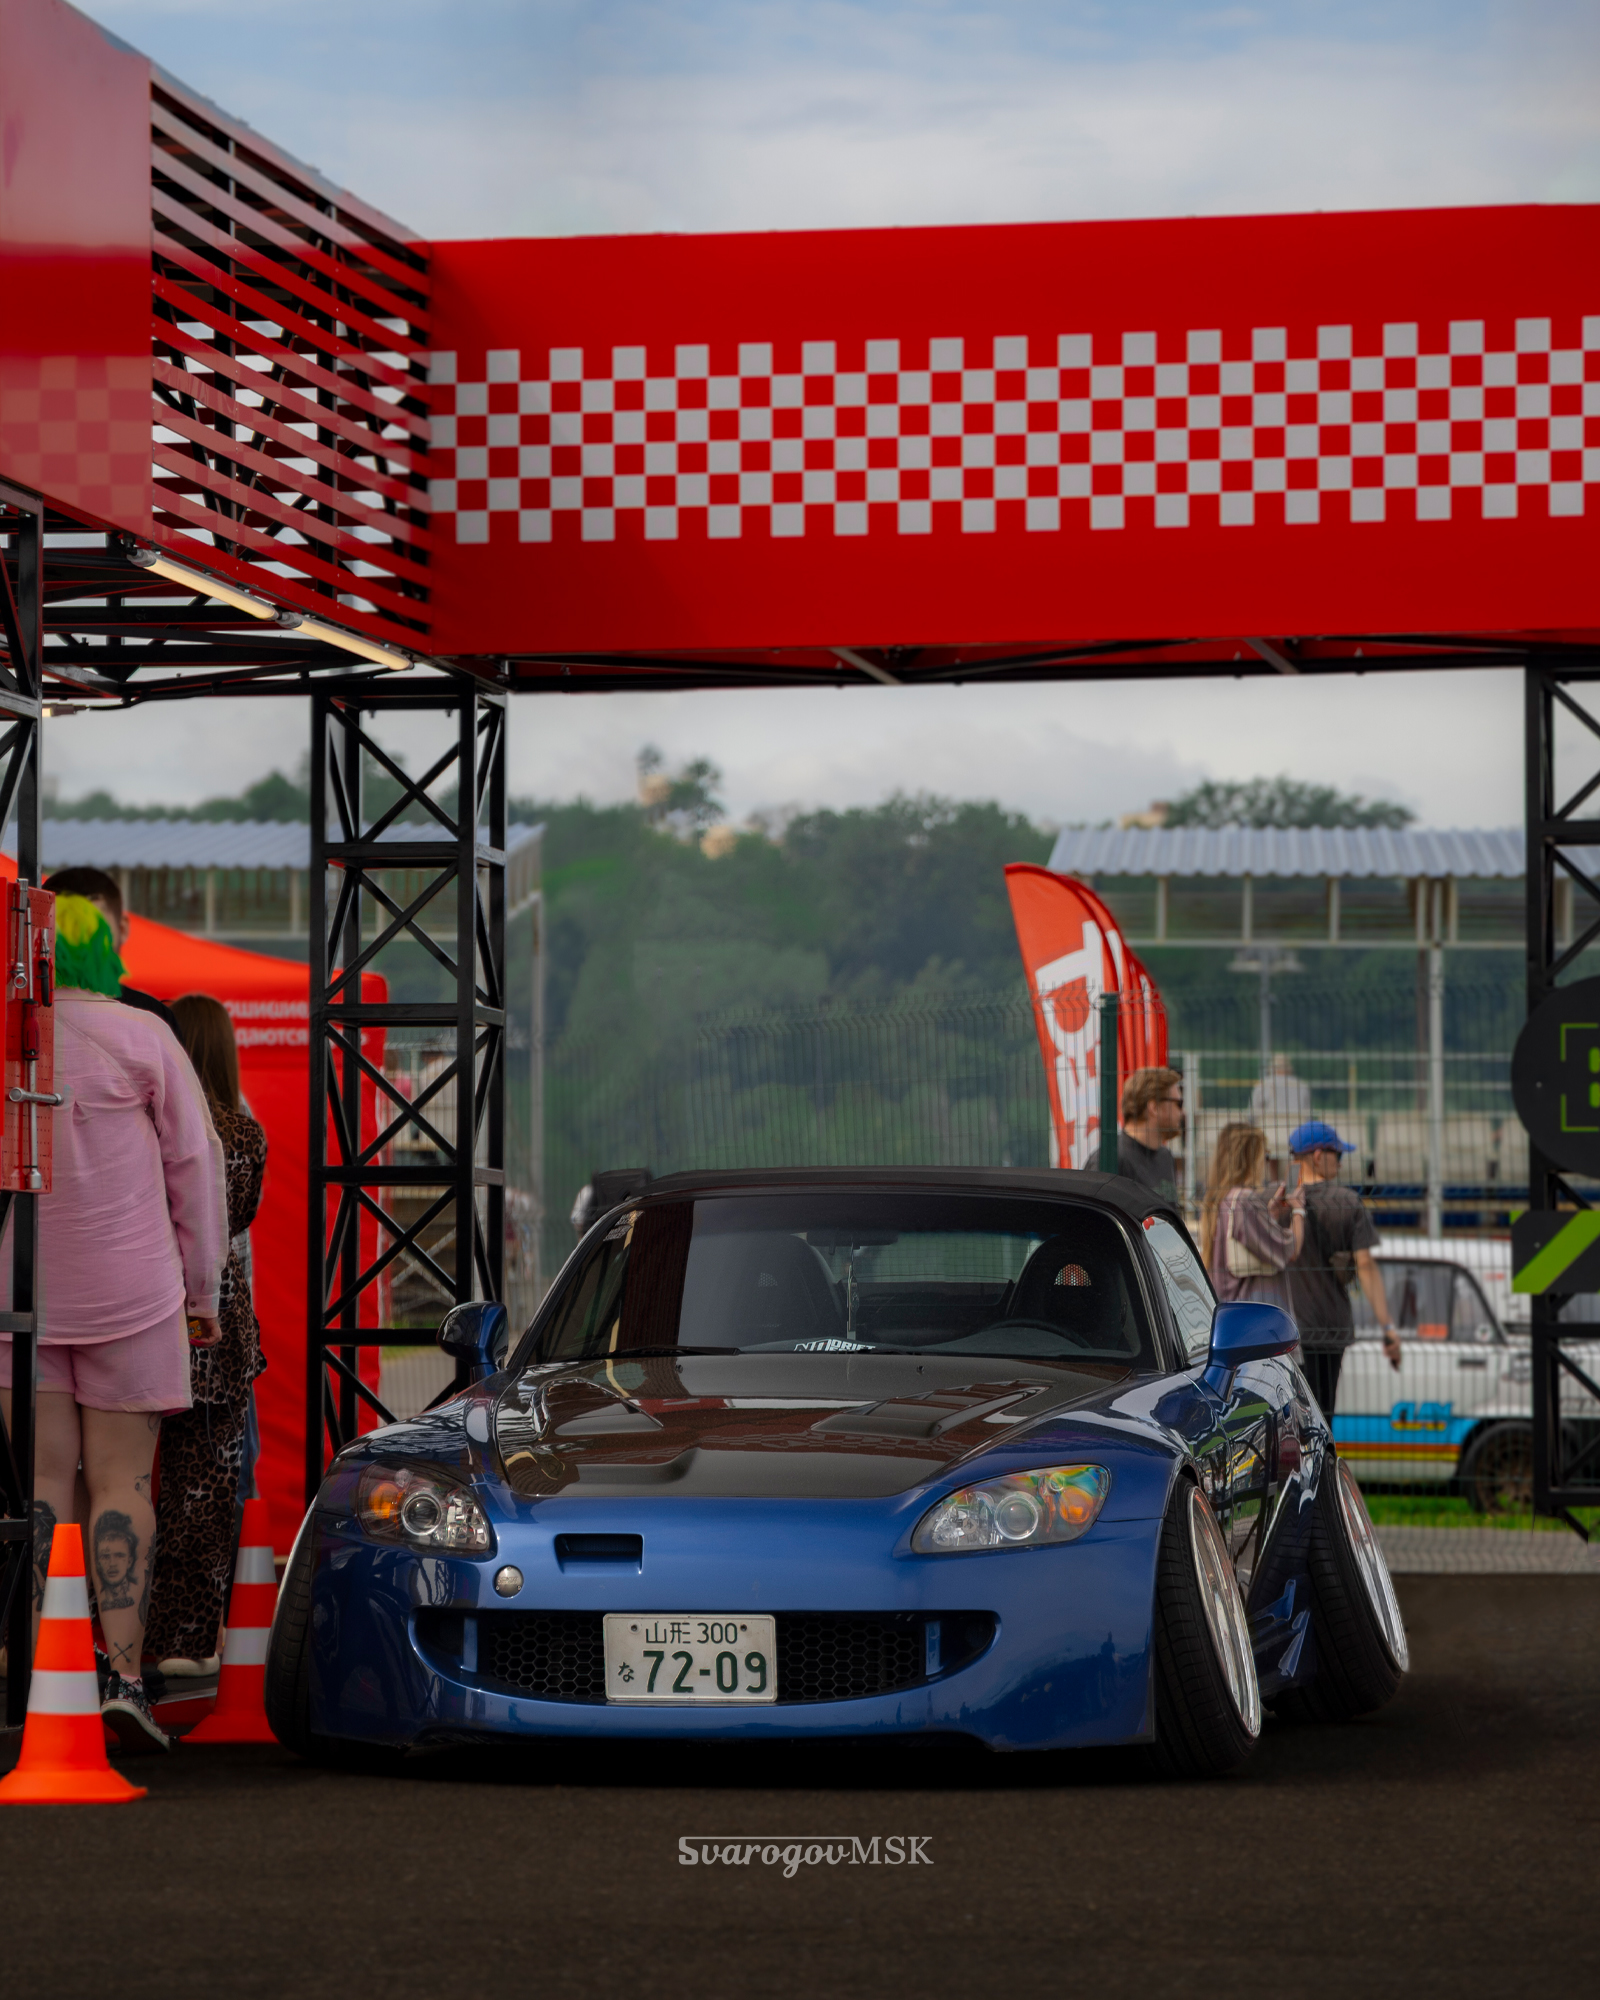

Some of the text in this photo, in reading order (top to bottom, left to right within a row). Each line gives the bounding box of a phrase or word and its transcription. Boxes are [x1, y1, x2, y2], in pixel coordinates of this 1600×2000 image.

[645, 1621, 738, 1644] 山形 300
[617, 1650, 767, 1694] な 72-09
